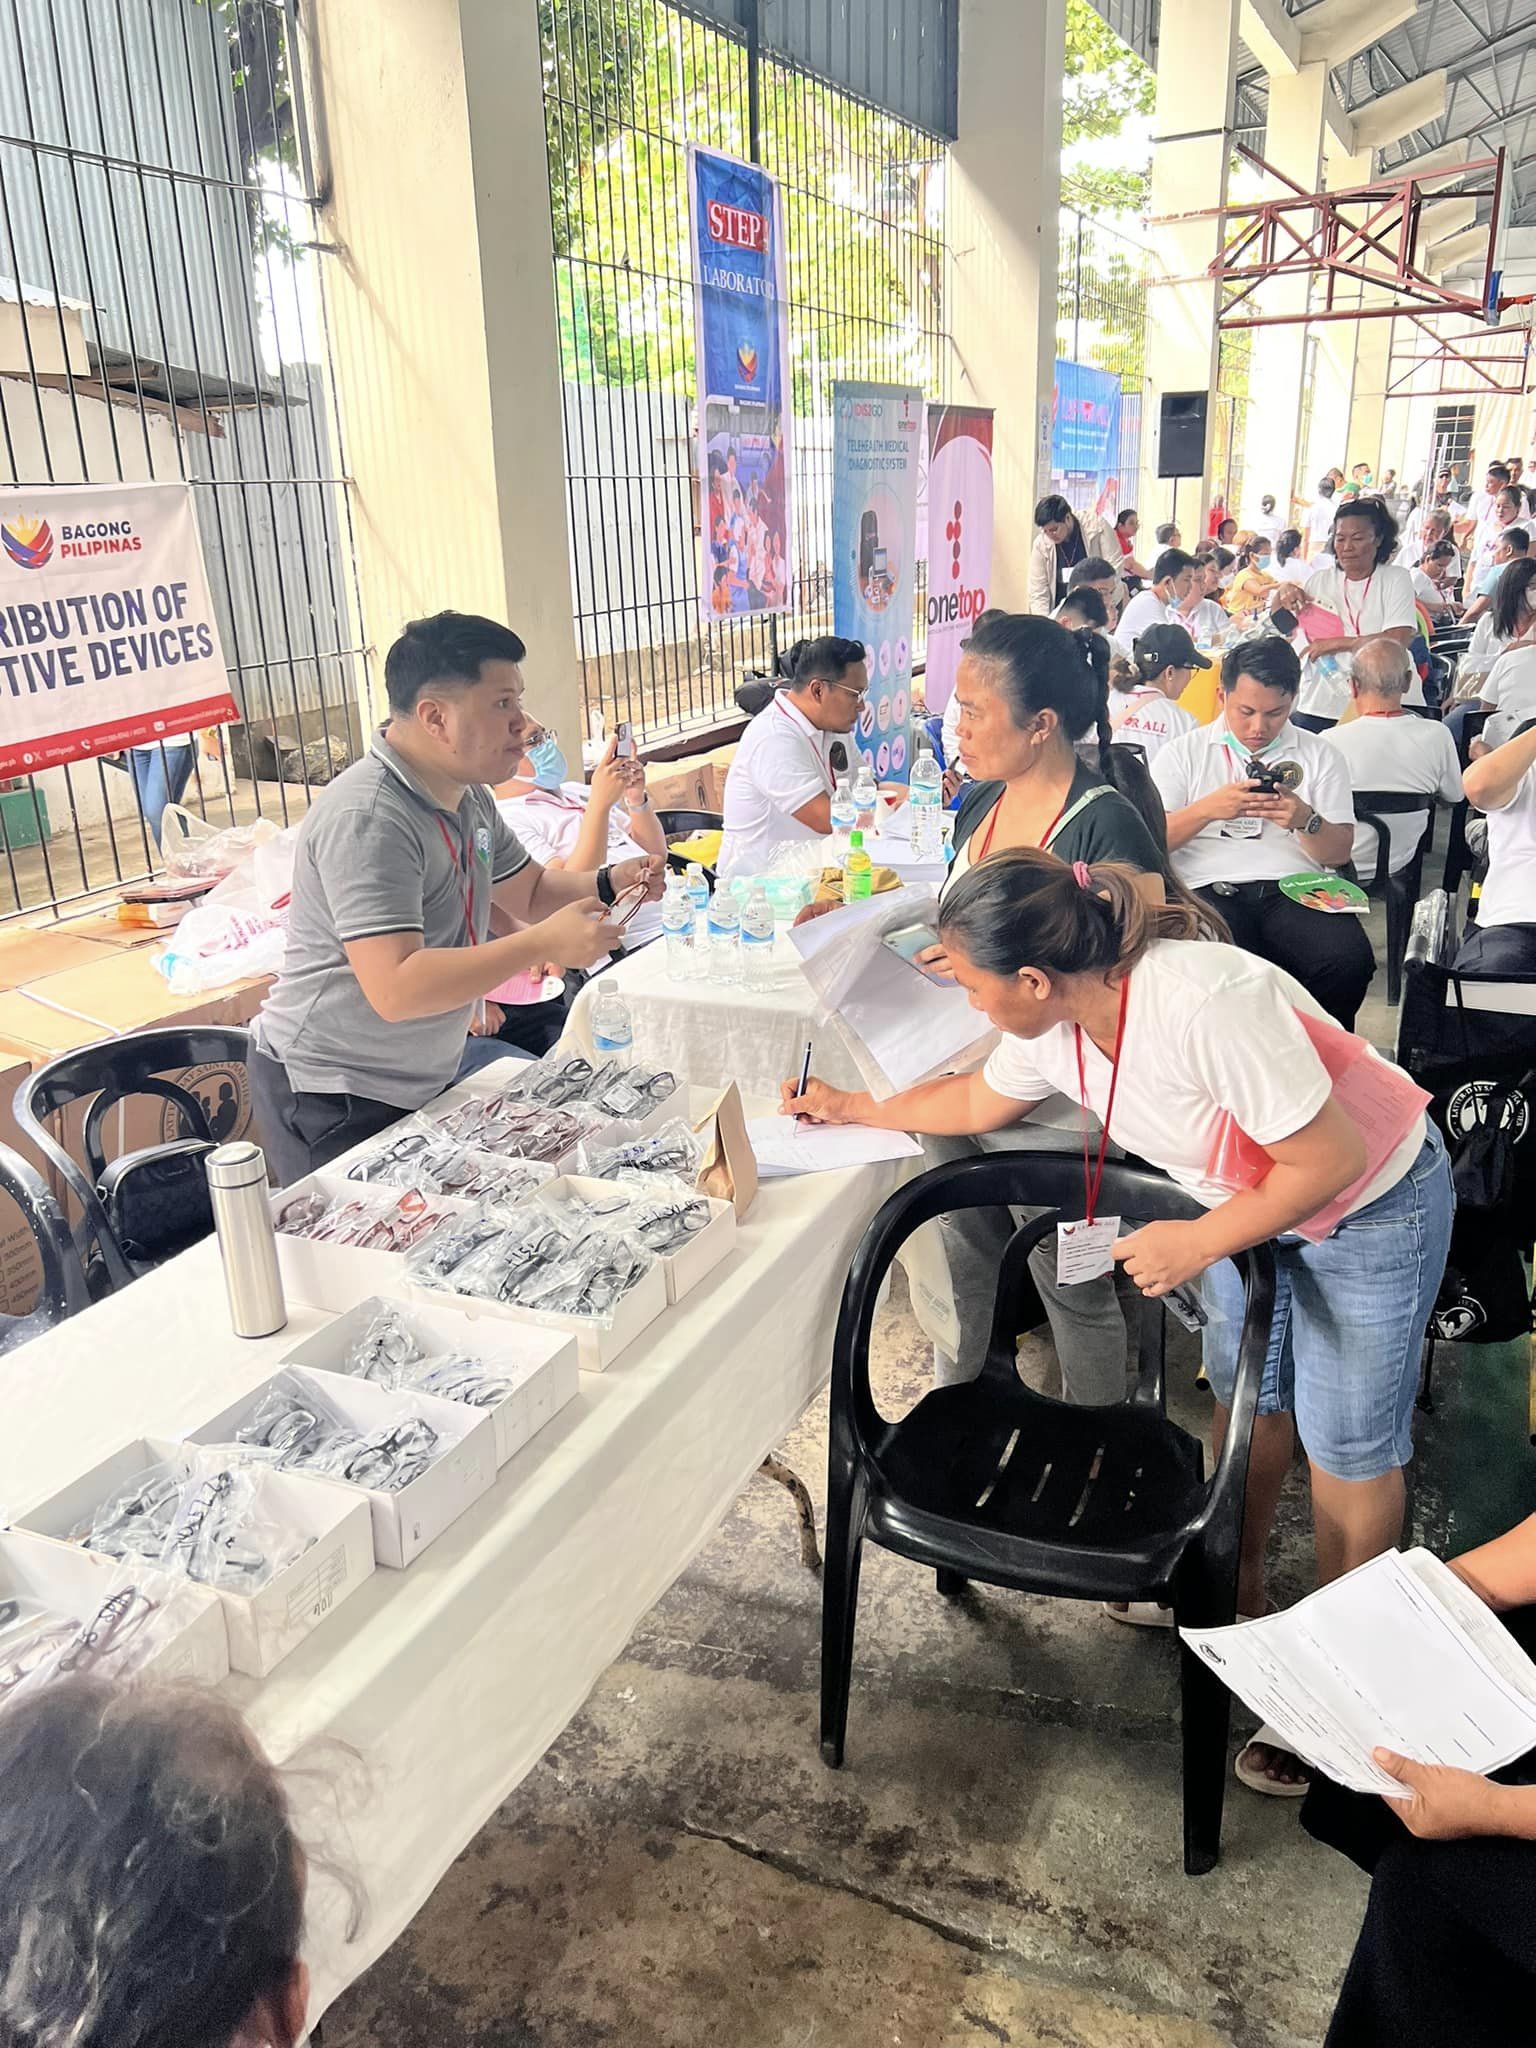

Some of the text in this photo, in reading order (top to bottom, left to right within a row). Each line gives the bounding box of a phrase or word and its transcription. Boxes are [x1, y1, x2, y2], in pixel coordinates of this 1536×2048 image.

[710, 203, 761, 248] STEP
[847, 439, 910, 453] TELEHEALTH MEDICAL
[885, 457, 908, 470] SYSTEM
[62, 521, 132, 541] BAGONG
[60, 537, 142, 559] PILIPINAS
[152, 582, 188, 623] OF
[927, 584, 986, 626] onetop
[0, 622, 214, 697] TIVE DEVICES
[1142, 720, 1168, 734] ALL
